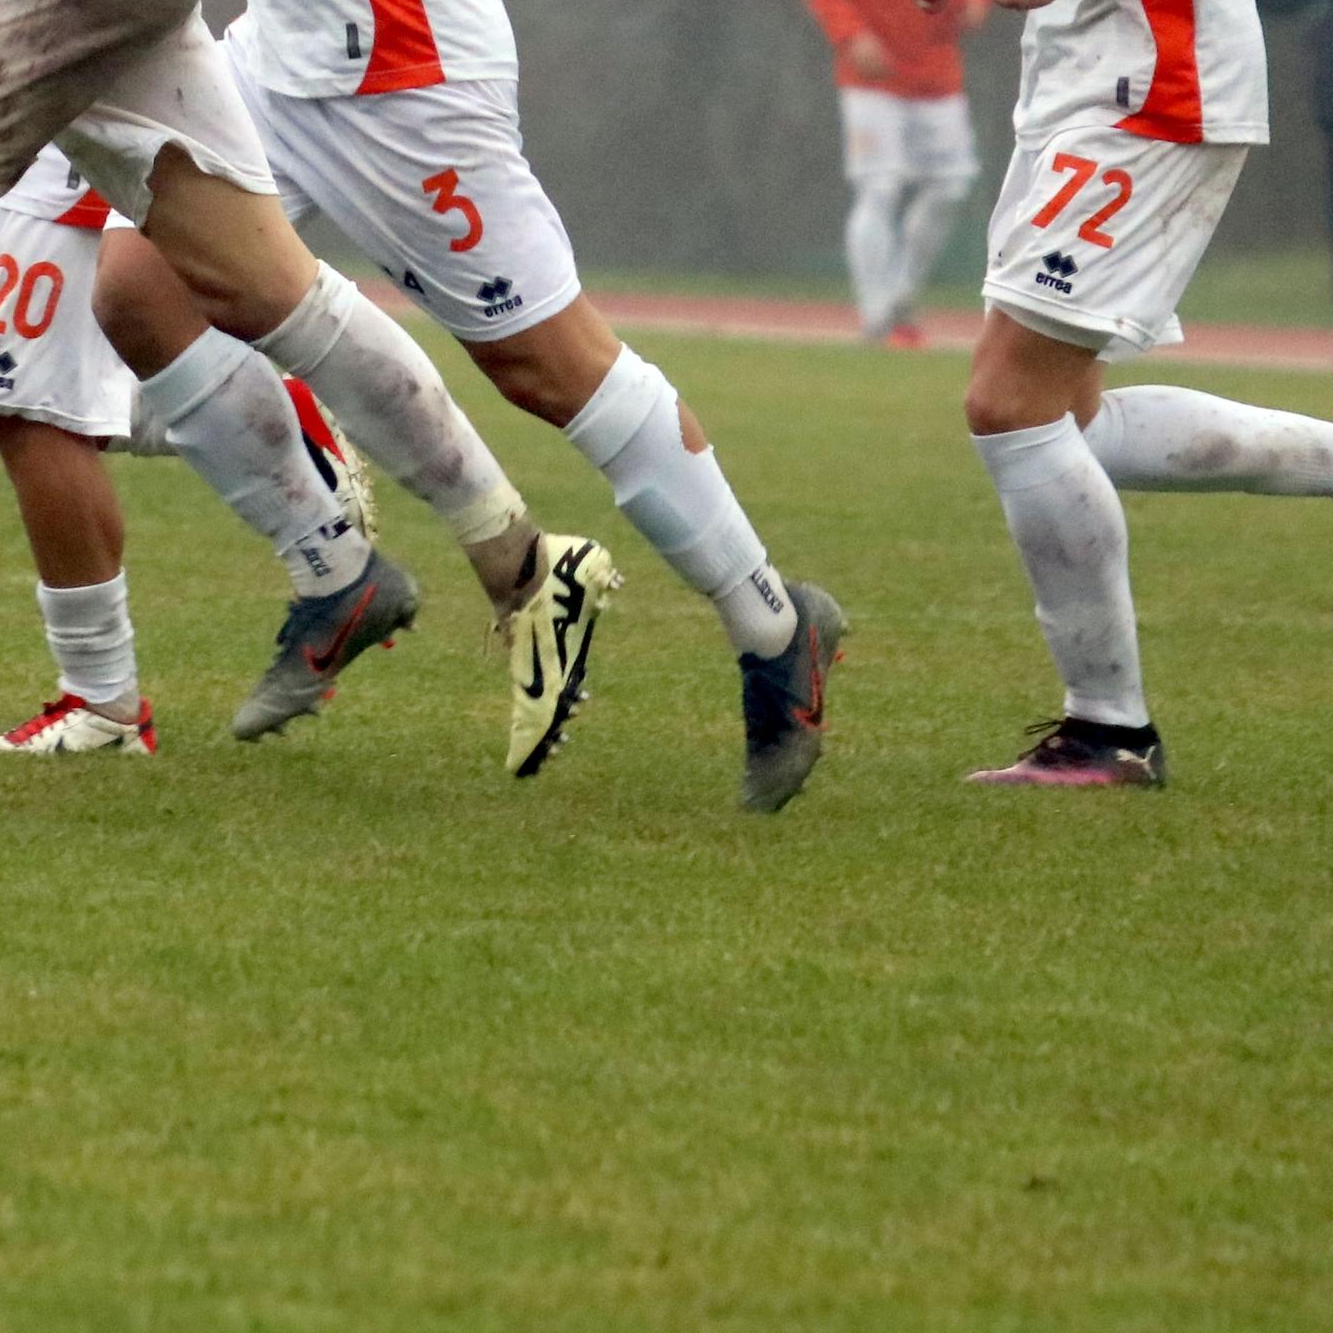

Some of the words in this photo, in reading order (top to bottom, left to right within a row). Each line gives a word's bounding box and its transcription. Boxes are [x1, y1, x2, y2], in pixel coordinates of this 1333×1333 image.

[422, 167, 484, 252] 3
[1030, 152, 1133, 250] 72
[484, 294, 523, 318] errea
[1035, 271, 1073, 295] errea
